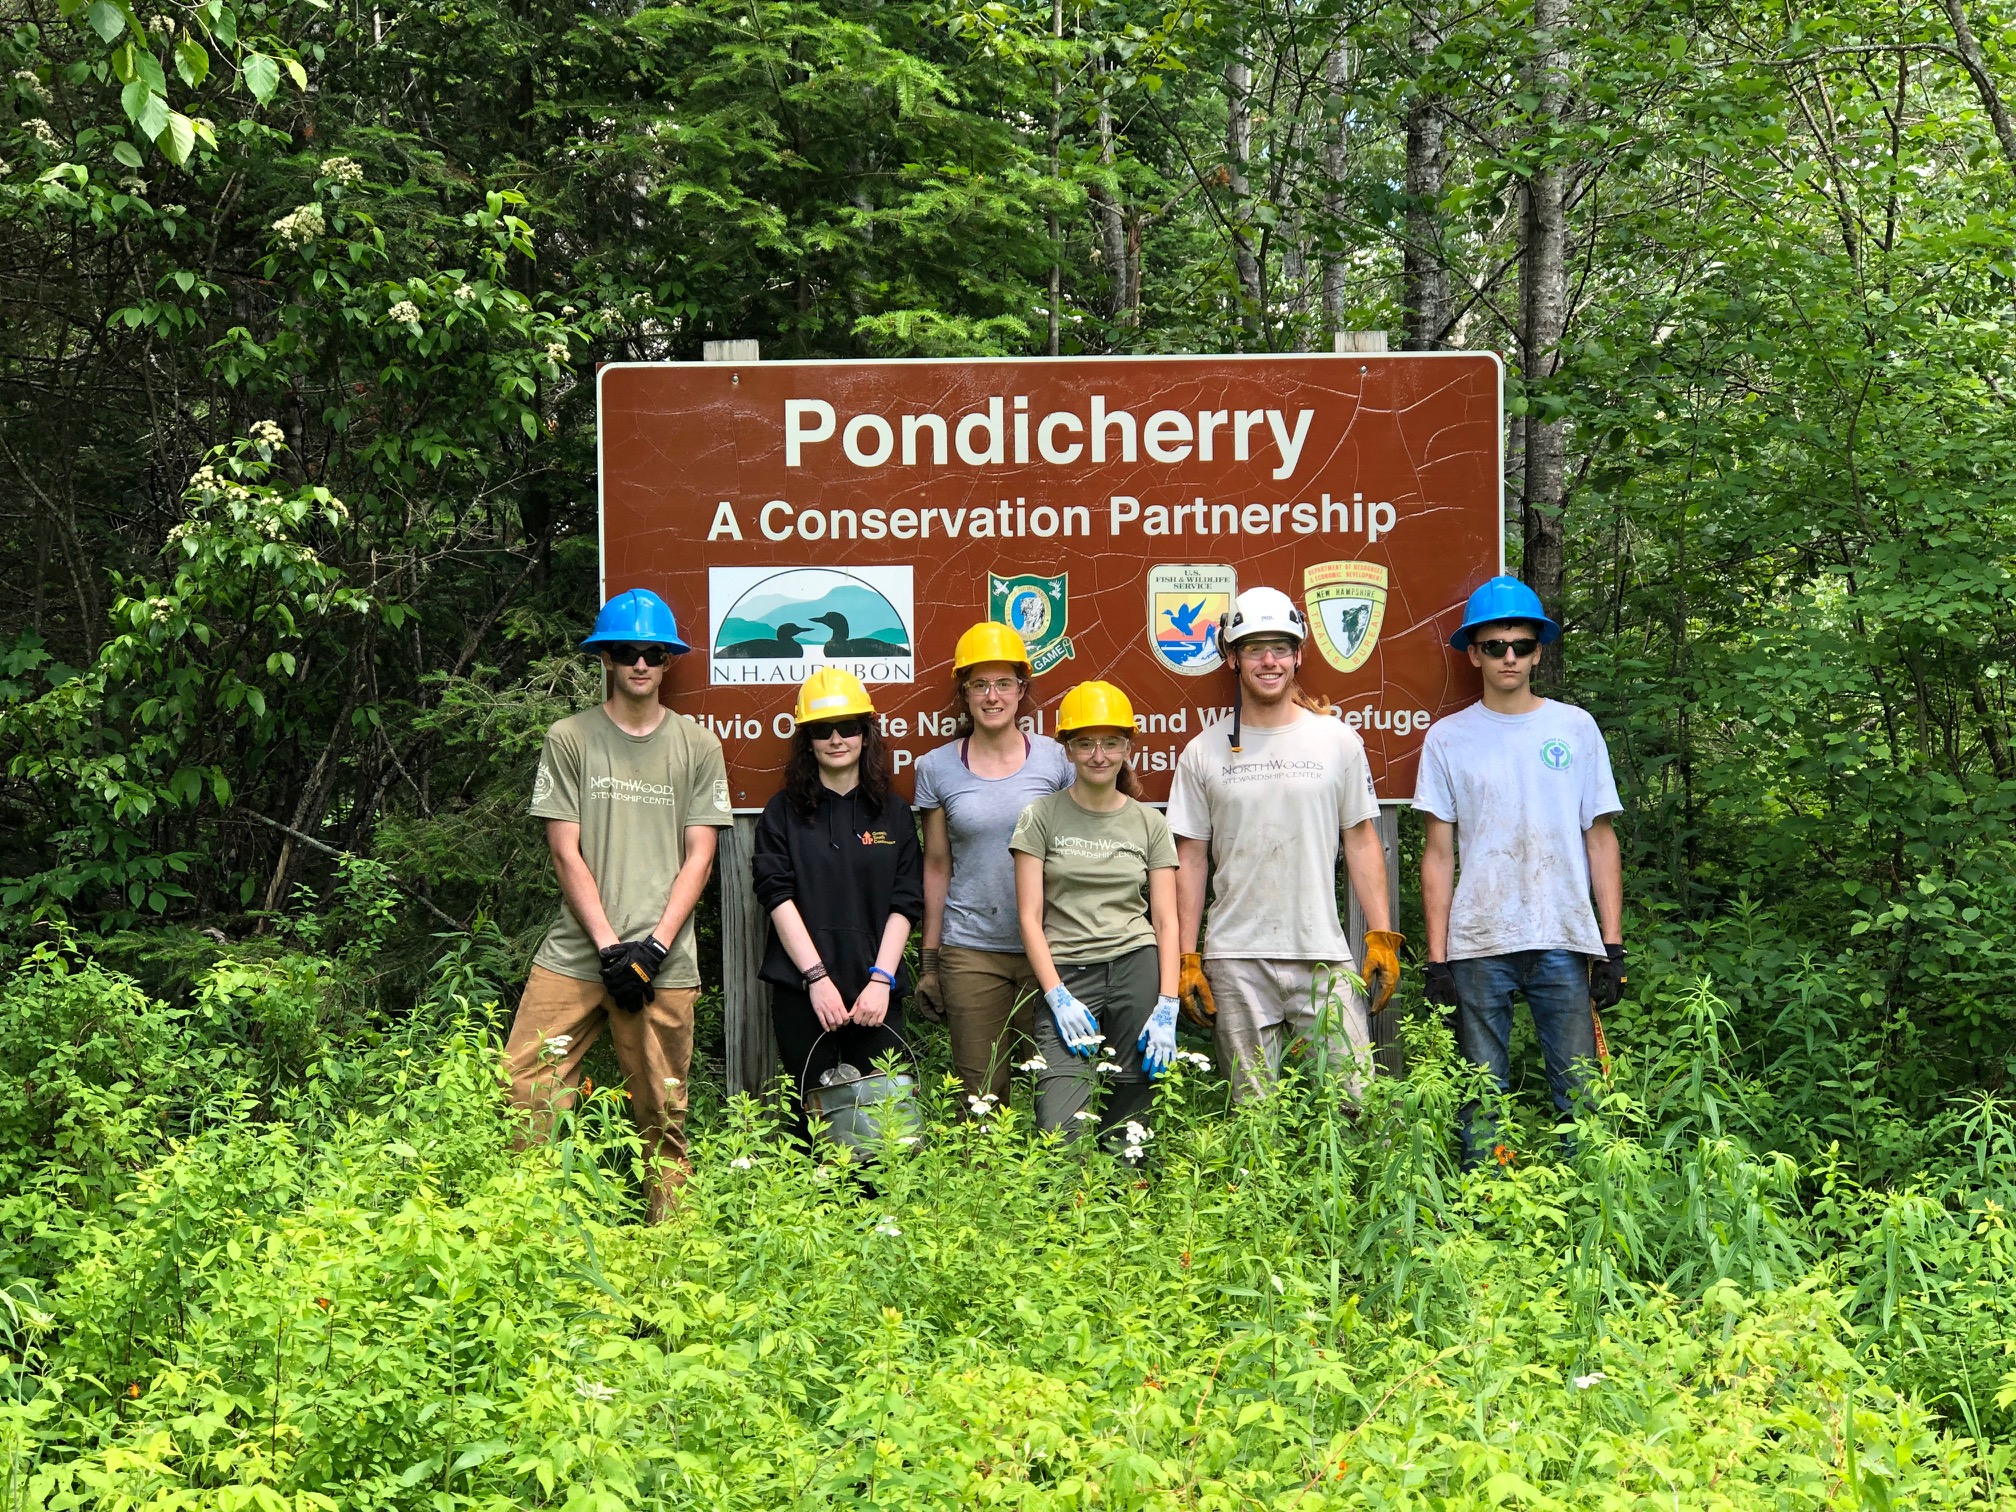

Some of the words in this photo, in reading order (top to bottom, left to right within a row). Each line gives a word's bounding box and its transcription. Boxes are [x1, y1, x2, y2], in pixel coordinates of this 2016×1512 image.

[784, 395, 1315, 480] Pondicherry
[707, 501, 743, 542] A
[758, 497, 1090, 542] Conservation
[1110, 492, 1397, 543] Partnership
[1307, 564, 1342, 576] DEPARTMENT
[1346, 571, 1383, 582] DEVELOPMENT
[1316, 589, 1331, 599] NEW
[1335, 588, 1376, 599] HAMPSHIRE
[1311, 610, 1340, 664] TRAILS
[1352, 610, 1381, 665] BUREAU
[1033, 644, 1065, 671] GAME
[713, 663, 911, 683] N.H.AUBON
[1222, 772, 1285, 786] STEWARDSHIP
[1286, 771, 1322, 780] CENTER
[861, 837, 873, 845] UP
